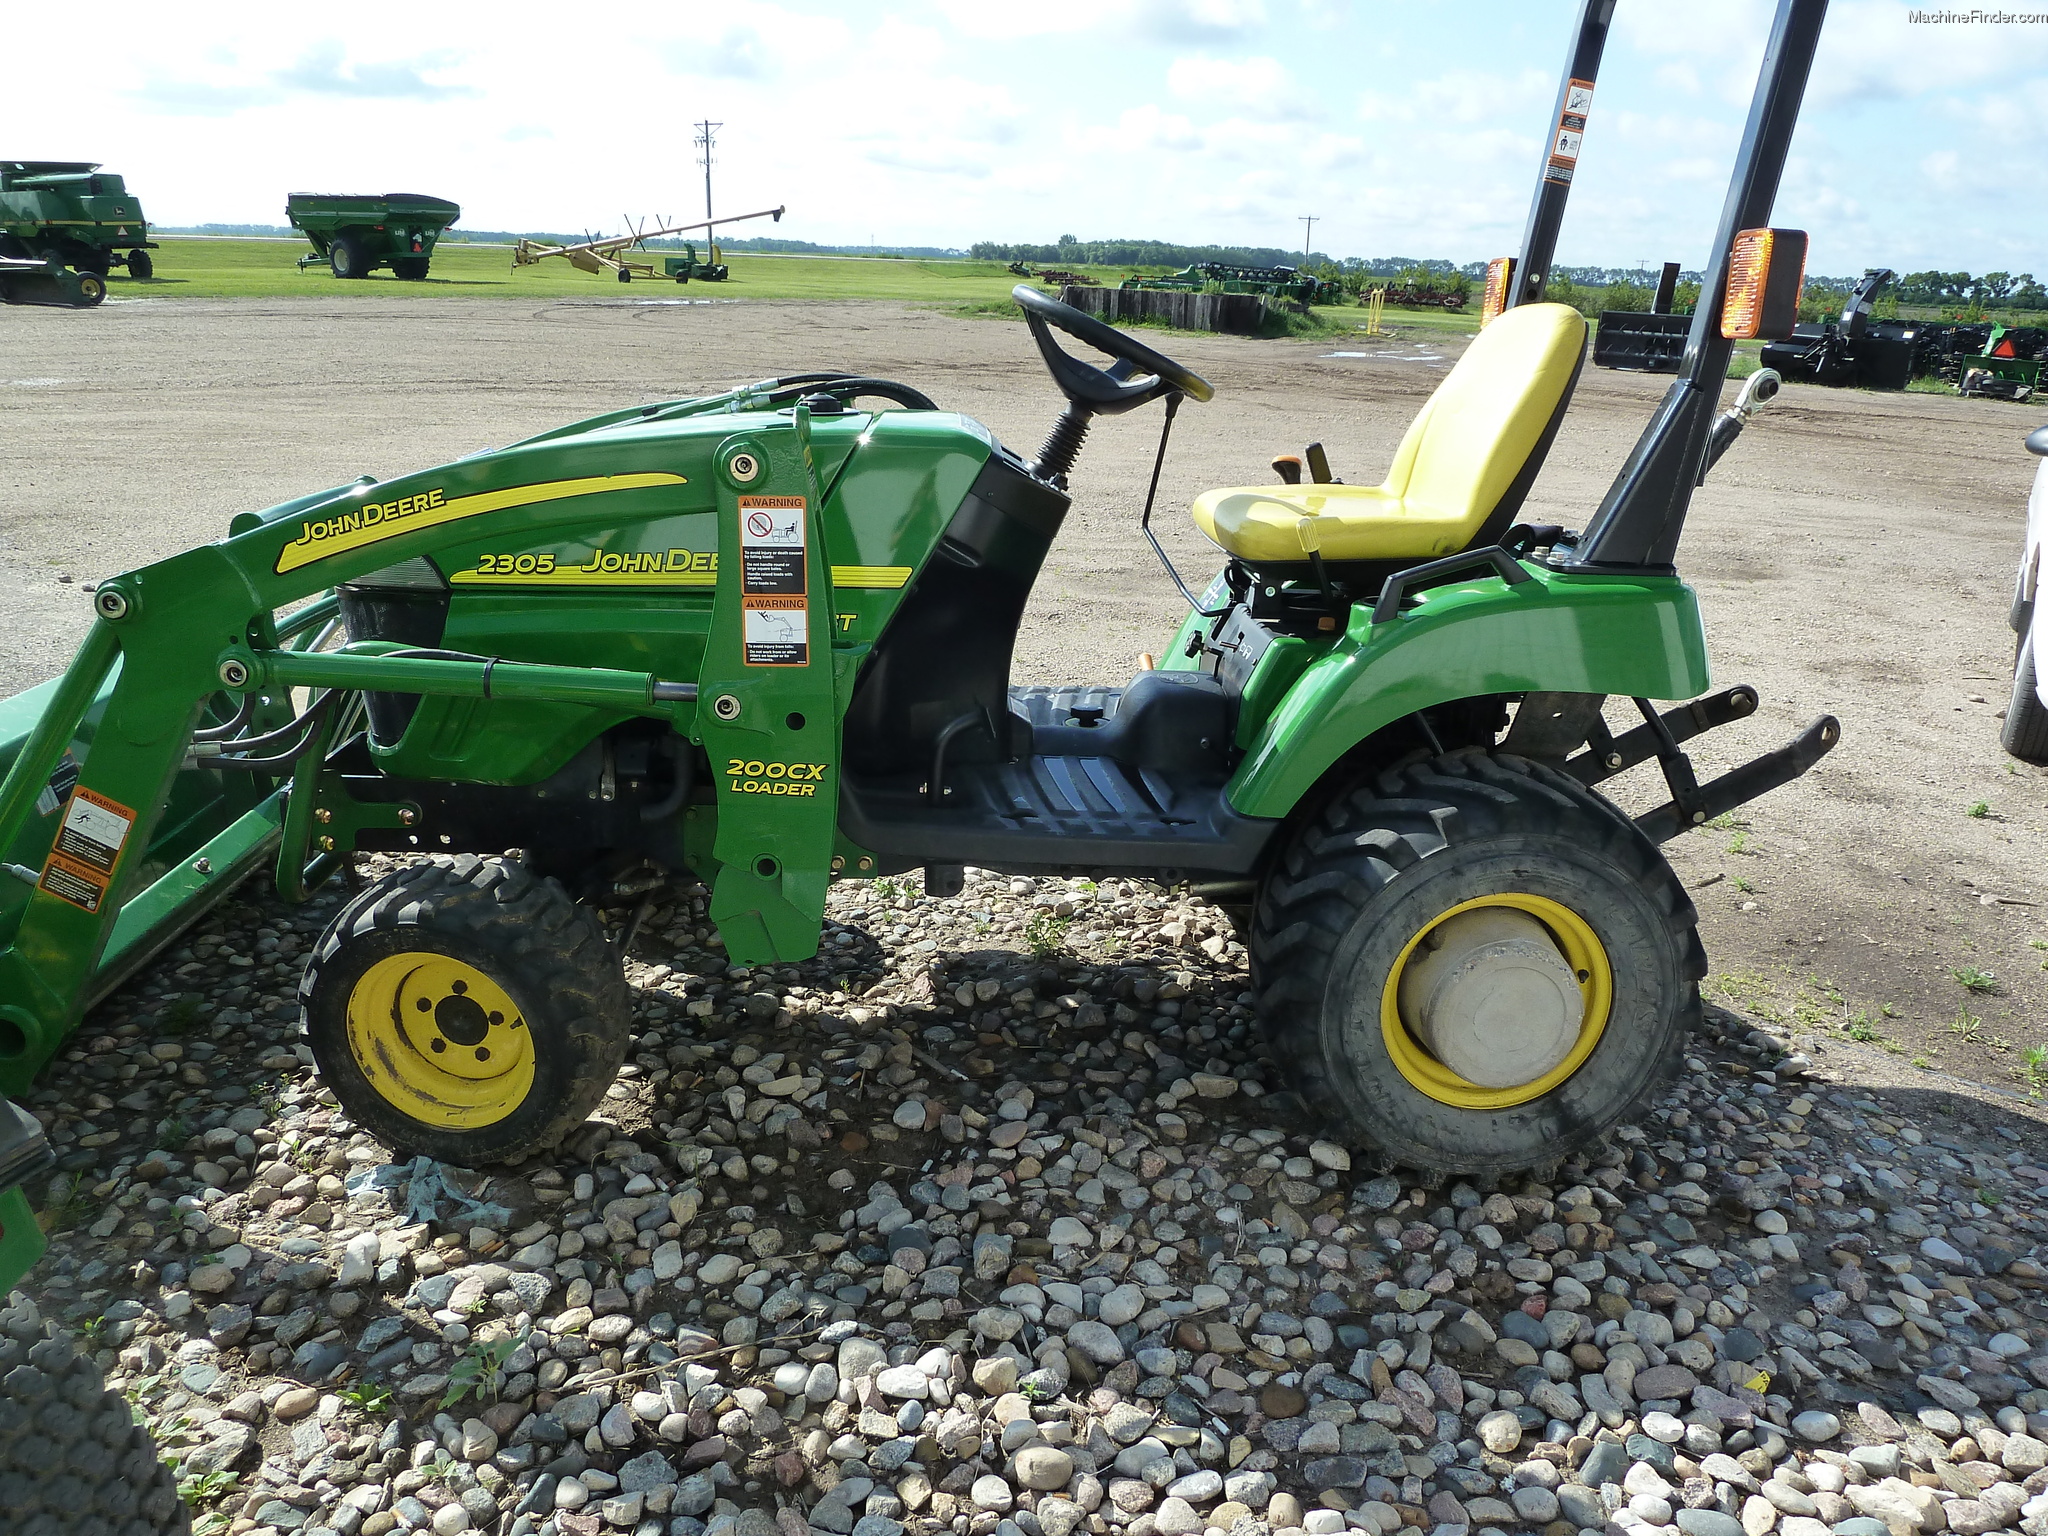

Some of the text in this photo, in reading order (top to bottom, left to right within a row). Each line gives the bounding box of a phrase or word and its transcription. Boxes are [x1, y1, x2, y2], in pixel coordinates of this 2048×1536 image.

[752, 497, 802, 507] WARNING
[296, 489, 446, 546] JOHN DEERE
[476, 553, 556, 576] 2305
[581, 548, 660, 573] JOHN
[755, 599, 805, 609] WARNING
[725, 758, 830, 782] 200CX
[730, 779, 816, 798] LOADER
[91, 794, 128, 817] WARNING
[64, 862, 102, 884] WARNING
